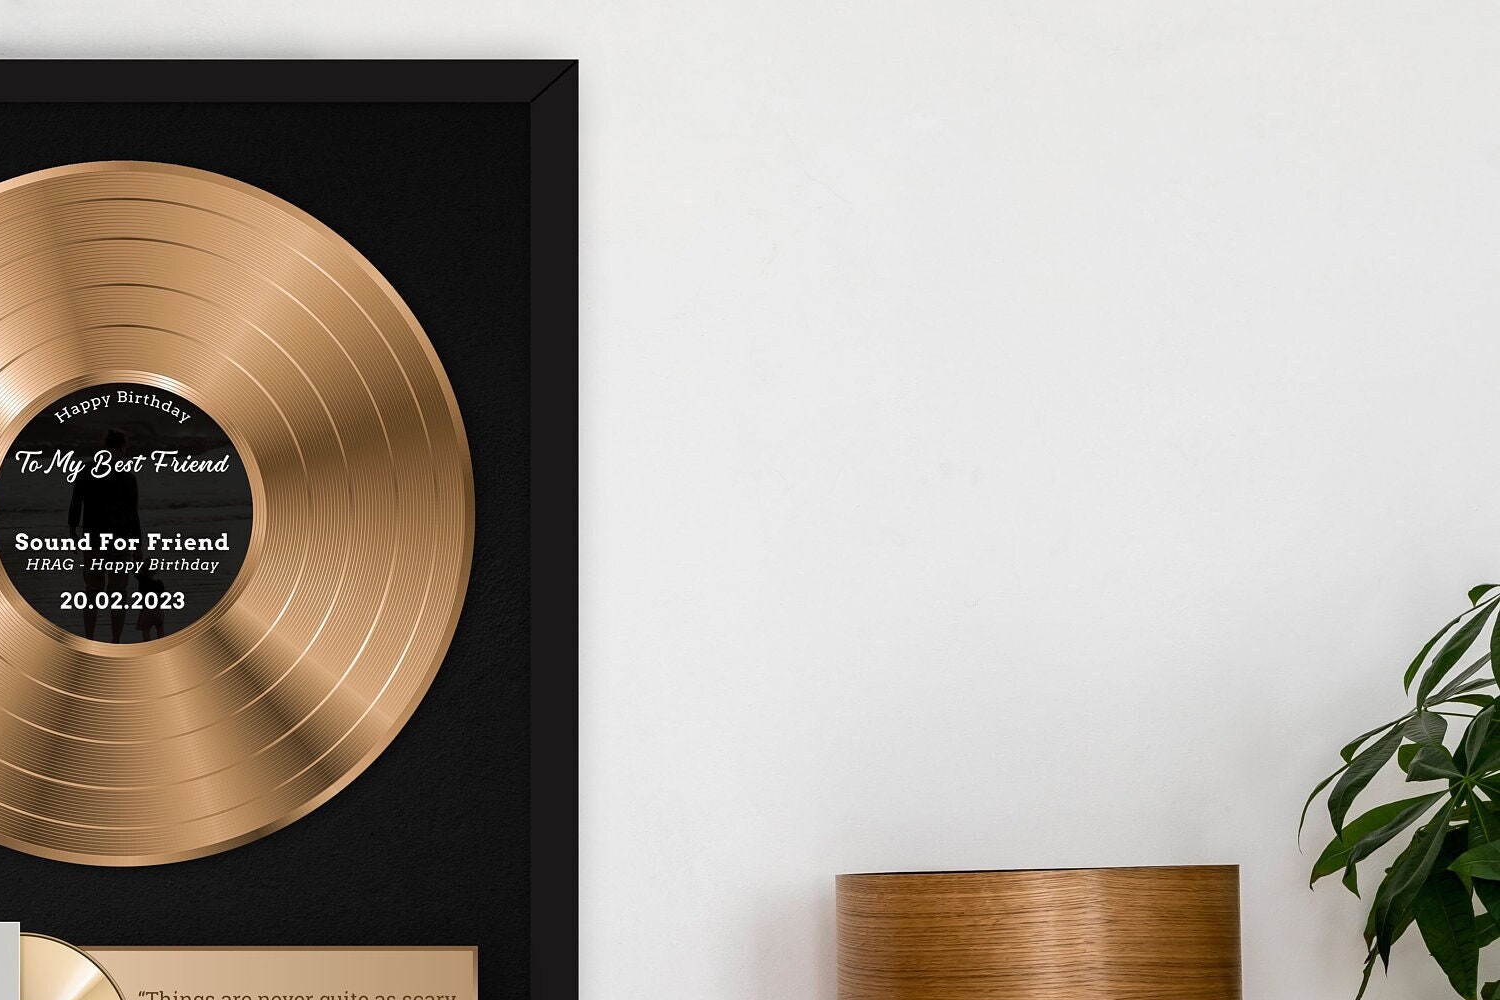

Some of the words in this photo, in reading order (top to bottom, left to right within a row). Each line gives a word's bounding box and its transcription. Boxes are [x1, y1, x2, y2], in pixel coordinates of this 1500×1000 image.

[54, 394, 111, 424] Happy
[117, 391, 192, 424] Birthday
[15, 450, 43, 474] To
[44, 449, 85, 483] My
[90, 449, 147, 478] Best
[150, 450, 230, 474] Friend
[15, 533, 92, 551] Sound
[99, 533, 140, 551] For
[147, 533, 230, 551] Friend
[25, 558, 74, 571] HRAG
[90, 558, 145, 573] Happy
[148, 558, 220, 573] Birthday
[60, 591, 186, 610] 20.02.2023
